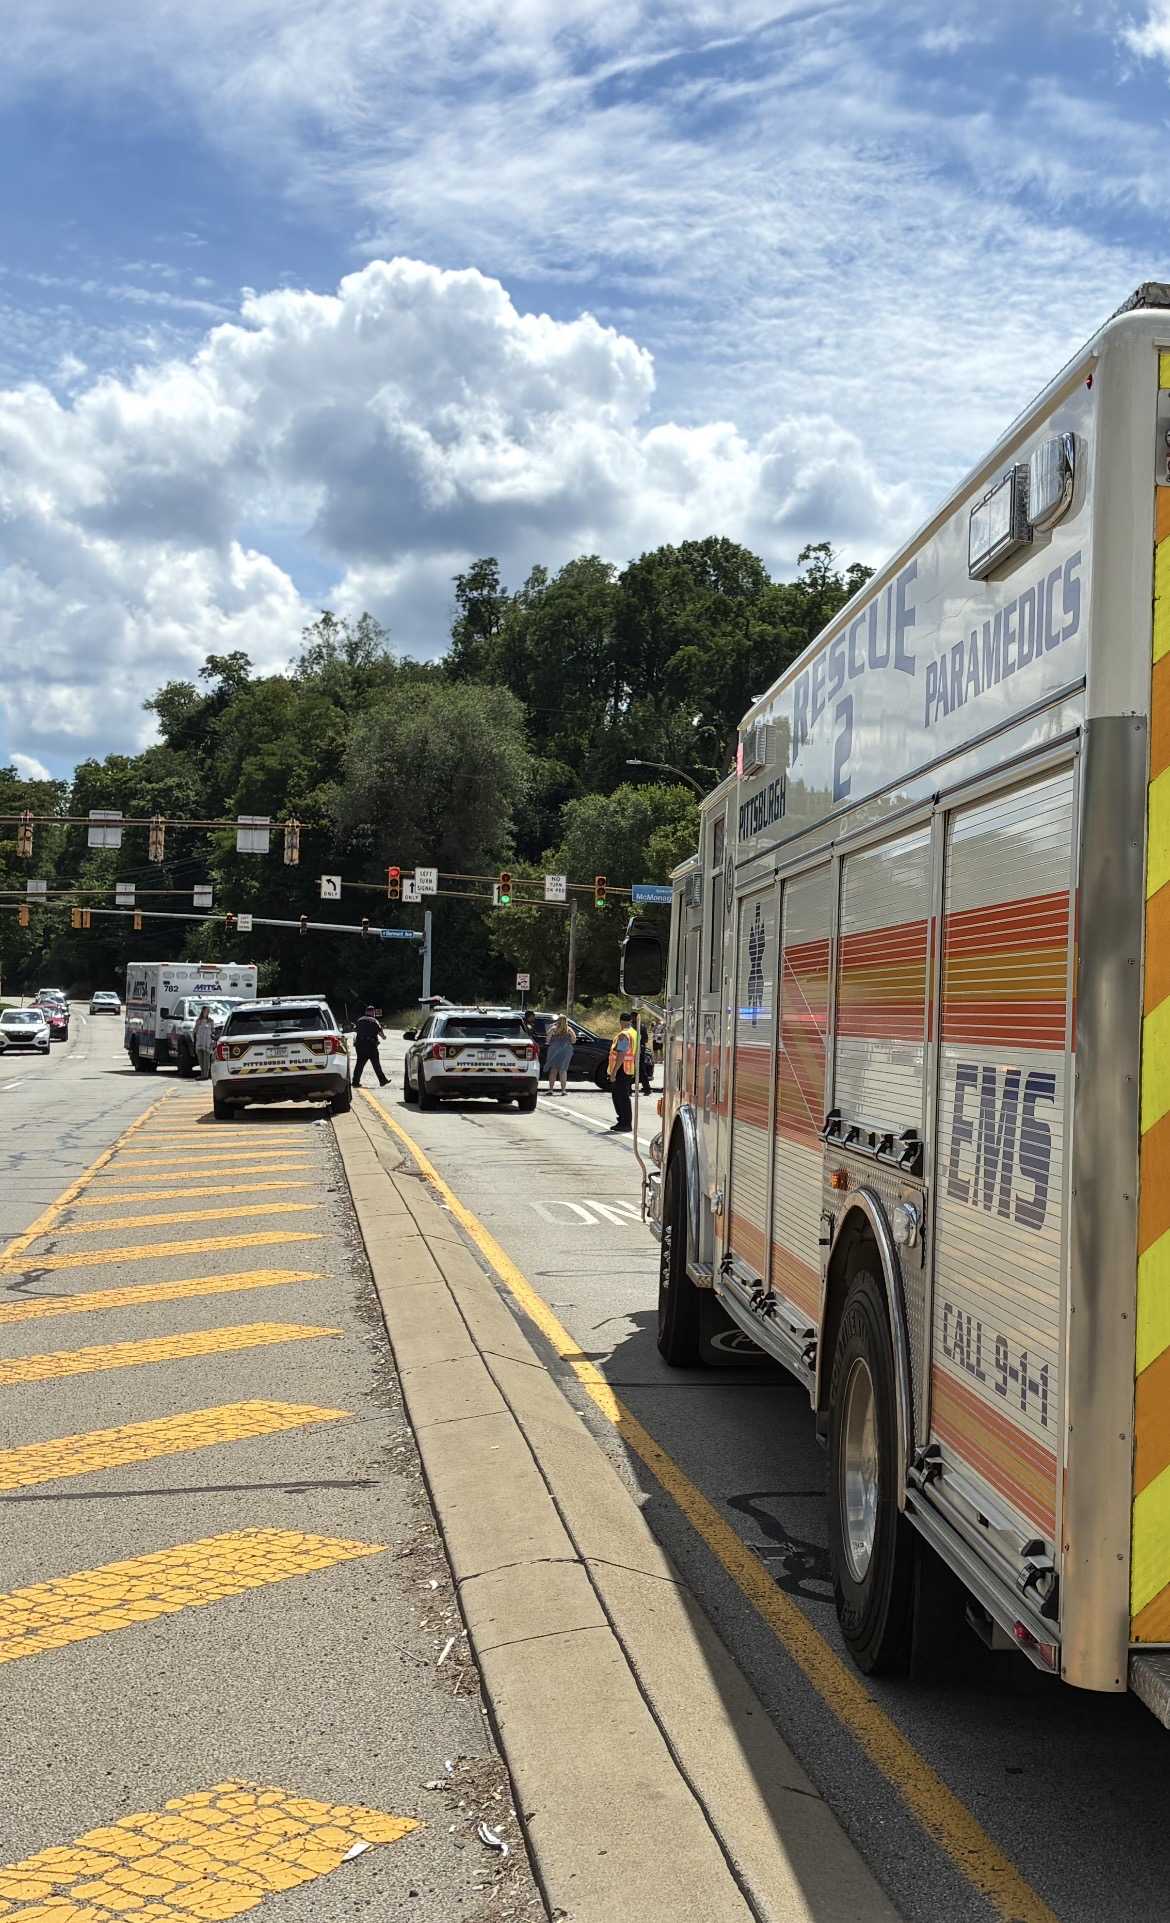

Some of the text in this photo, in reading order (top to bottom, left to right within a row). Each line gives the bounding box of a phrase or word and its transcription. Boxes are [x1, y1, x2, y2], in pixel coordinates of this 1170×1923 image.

[791, 558, 918, 769] RESCUE
[924, 551, 1082, 728] PARAMEDICS
[738, 773, 786, 842] PITTSBURGH
[832, 694, 854, 803] 2
[636, 893, 672, 902] McMonag
[946, 1063, 1057, 1231] EMS
[943, 1302, 986, 1375] CALL
[994, 1333, 1050, 1428] 9-1-1
